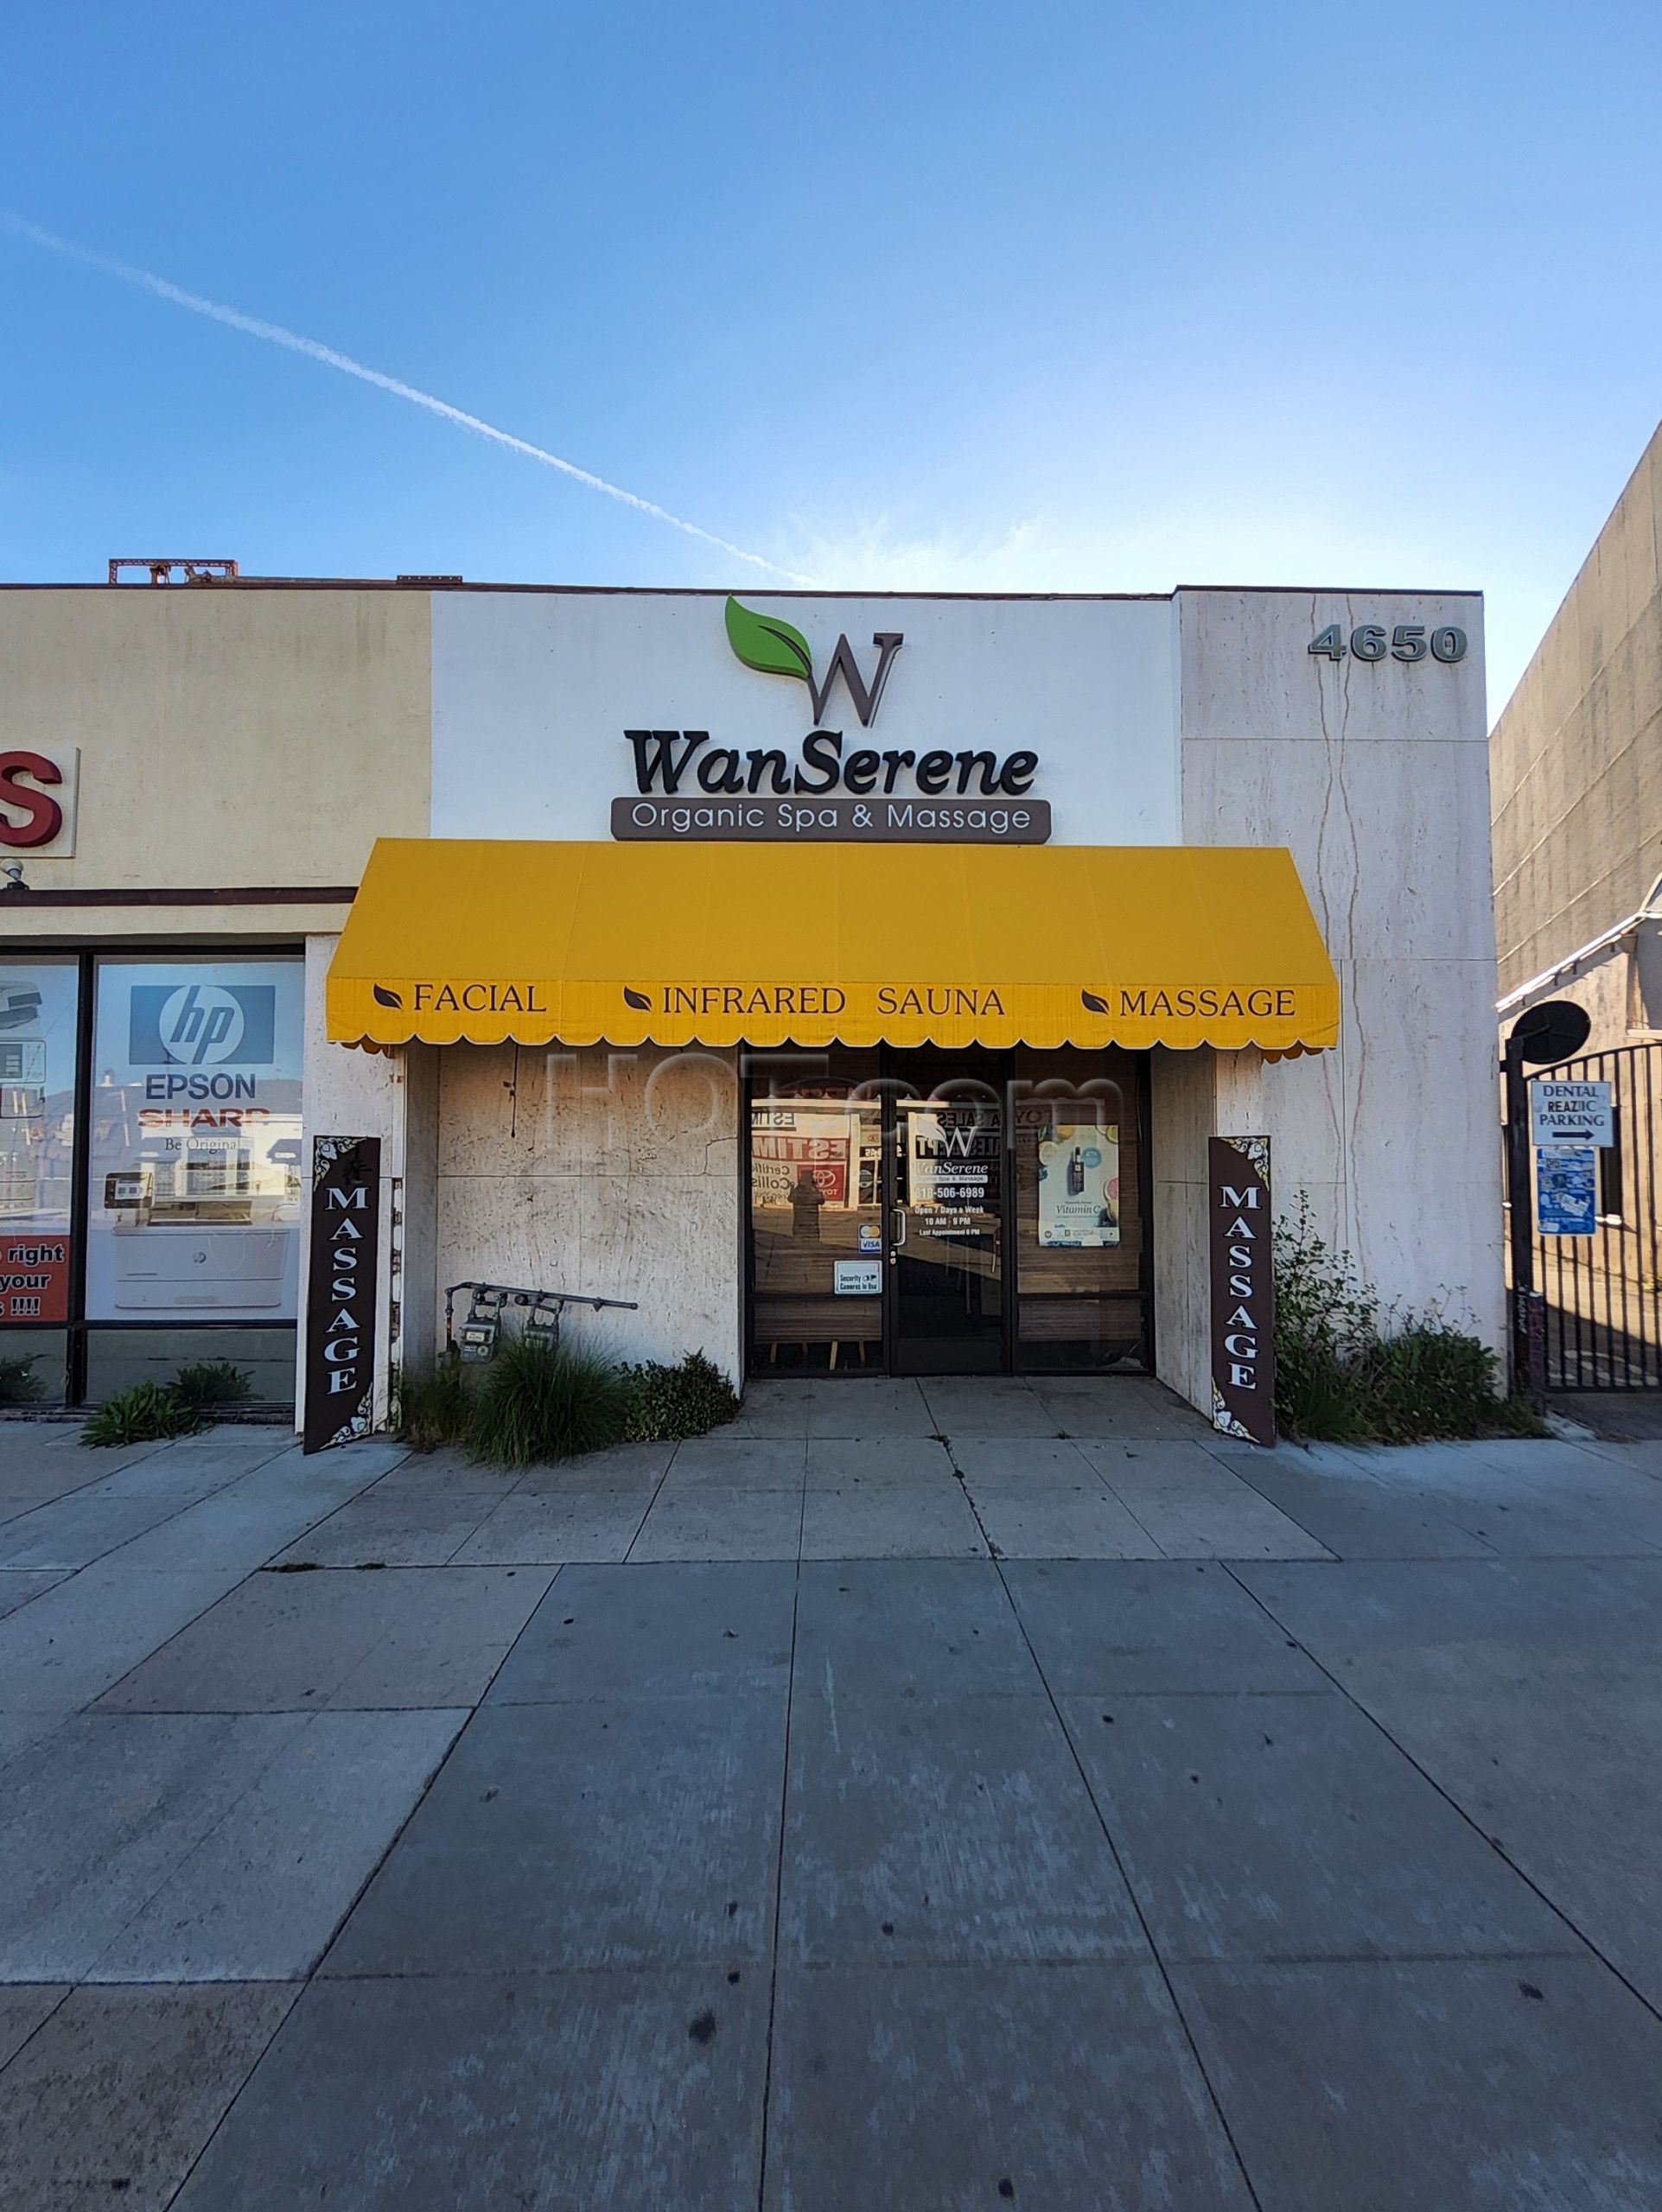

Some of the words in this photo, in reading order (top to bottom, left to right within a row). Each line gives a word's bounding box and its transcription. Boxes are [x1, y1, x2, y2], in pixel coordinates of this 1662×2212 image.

[1308, 624, 1468, 664] 4650
[623, 729, 1039, 796] WanSerene
[632, 803, 765, 834] Organic
[778, 803, 838, 833] Spa
[852, 804, 874, 829] &
[887, 804, 1032, 835] Massage
[413, 983, 548, 1014] FACIAL
[662, 986, 846, 1015] INFRARED
[876, 987, 1006, 1016] SAUNA
[1119, 988, 1296, 1017] MASSAGE
[169, 985, 235, 1065] hp
[145, 1072, 257, 1101] EPSON
[1542, 1085, 1600, 1098] DENTAL
[137, 1107, 271, 1128] SHARP
[1539, 1114, 1605, 1127] PARKING
[164, 1137, 182, 1151] Be
[914, 1186, 985, 1198] 818-506-6989
[914, 1205, 933, 1215] Open
[940, 1205, 958, 1215] Days
[965, 1205, 984, 1214] Week
[934, 1217, 946, 1225] AM
[959, 1217, 971, 1225] PM
[1056, 1205, 1092, 1215] Vitamin
[8, 1244, 66, 1268] right
[0, 1274, 52, 1295] your
[323, 1186, 370, 1396] MASSAGE
[1219, 1185, 1262, 1390] MASSAGE
